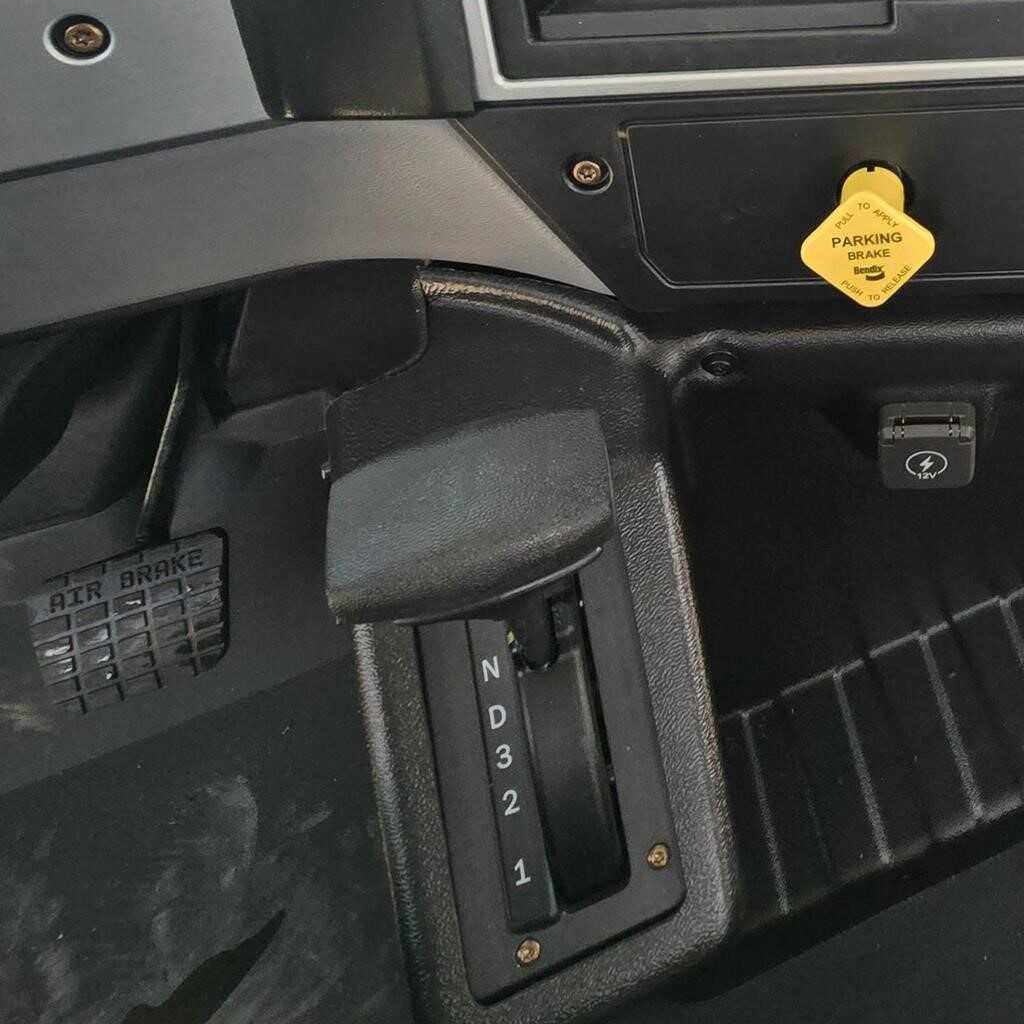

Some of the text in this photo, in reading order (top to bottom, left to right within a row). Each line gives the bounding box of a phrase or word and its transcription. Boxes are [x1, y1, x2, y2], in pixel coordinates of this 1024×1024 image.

[835, 202, 899, 229] PULL TO APPLY
[831, 232, 903, 248] PARKING
[848, 248, 891, 260] BRAKE
[841, 279, 864, 297] PUSH
[881, 264, 912, 294] RELEASE
[854, 264, 884, 275] Bendix
[50, 549, 204, 613] AIR BRAKE
[481, 655, 500, 682] N
[488, 704, 507, 729] D
[496, 744, 513, 769] 3
[502, 789, 520, 816] 2
[514, 858, 532, 886] 1
